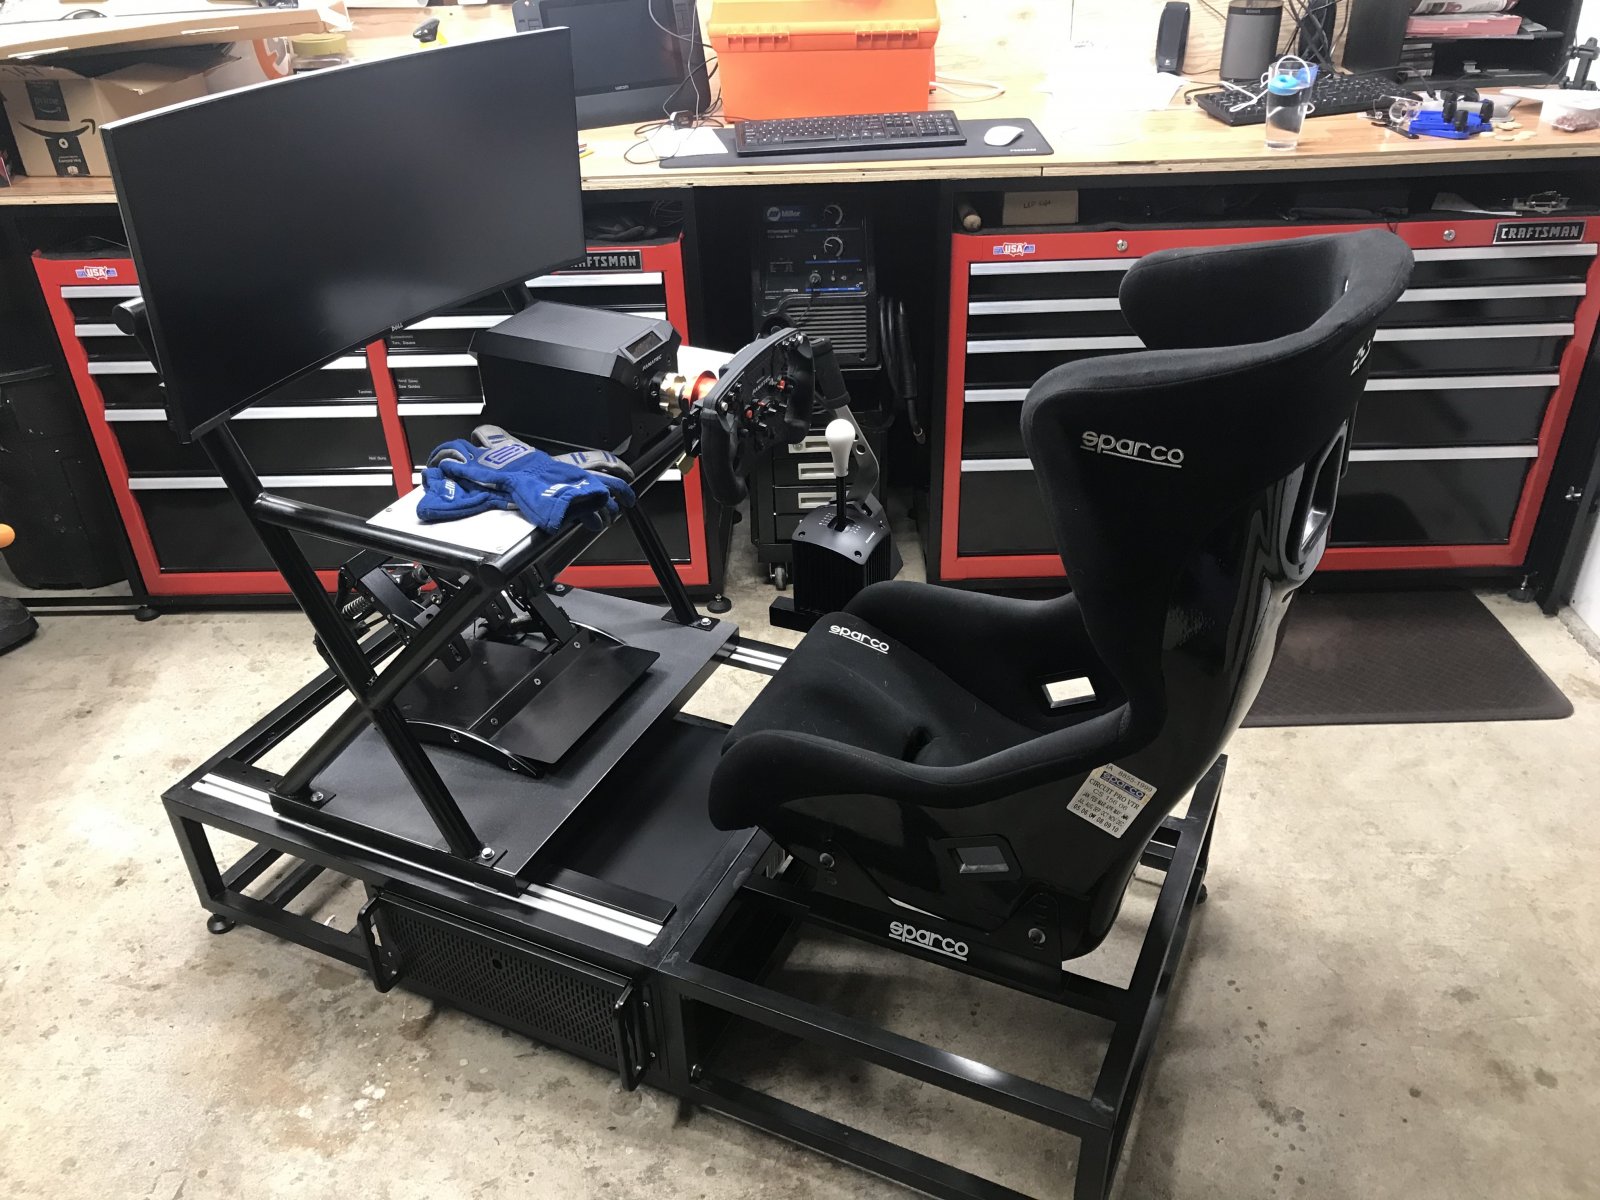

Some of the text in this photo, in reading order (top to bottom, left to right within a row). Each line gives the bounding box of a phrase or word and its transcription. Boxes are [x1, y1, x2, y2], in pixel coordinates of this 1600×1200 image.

[1500, 225, 1580, 239] CRAFTSMAN
[1004, 244, 1023, 254] USA
[86, 267, 106, 277] USA
[571, 255, 637, 268] FTSMAN
[1080, 430, 1184, 468] sparco
[829, 625, 889, 654] sparco
[1100, 771, 1146, 800] sparco
[1118, 770, 1153, 793] 8855-1999
[1088, 778, 1140, 810] CIRCUIT PRO VTR
[1092, 788, 1128, 811] CS 156 06
[1073, 803, 1081, 811] 05
[1104, 821, 1112, 829] 09
[888, 921, 969, 962] sparco
